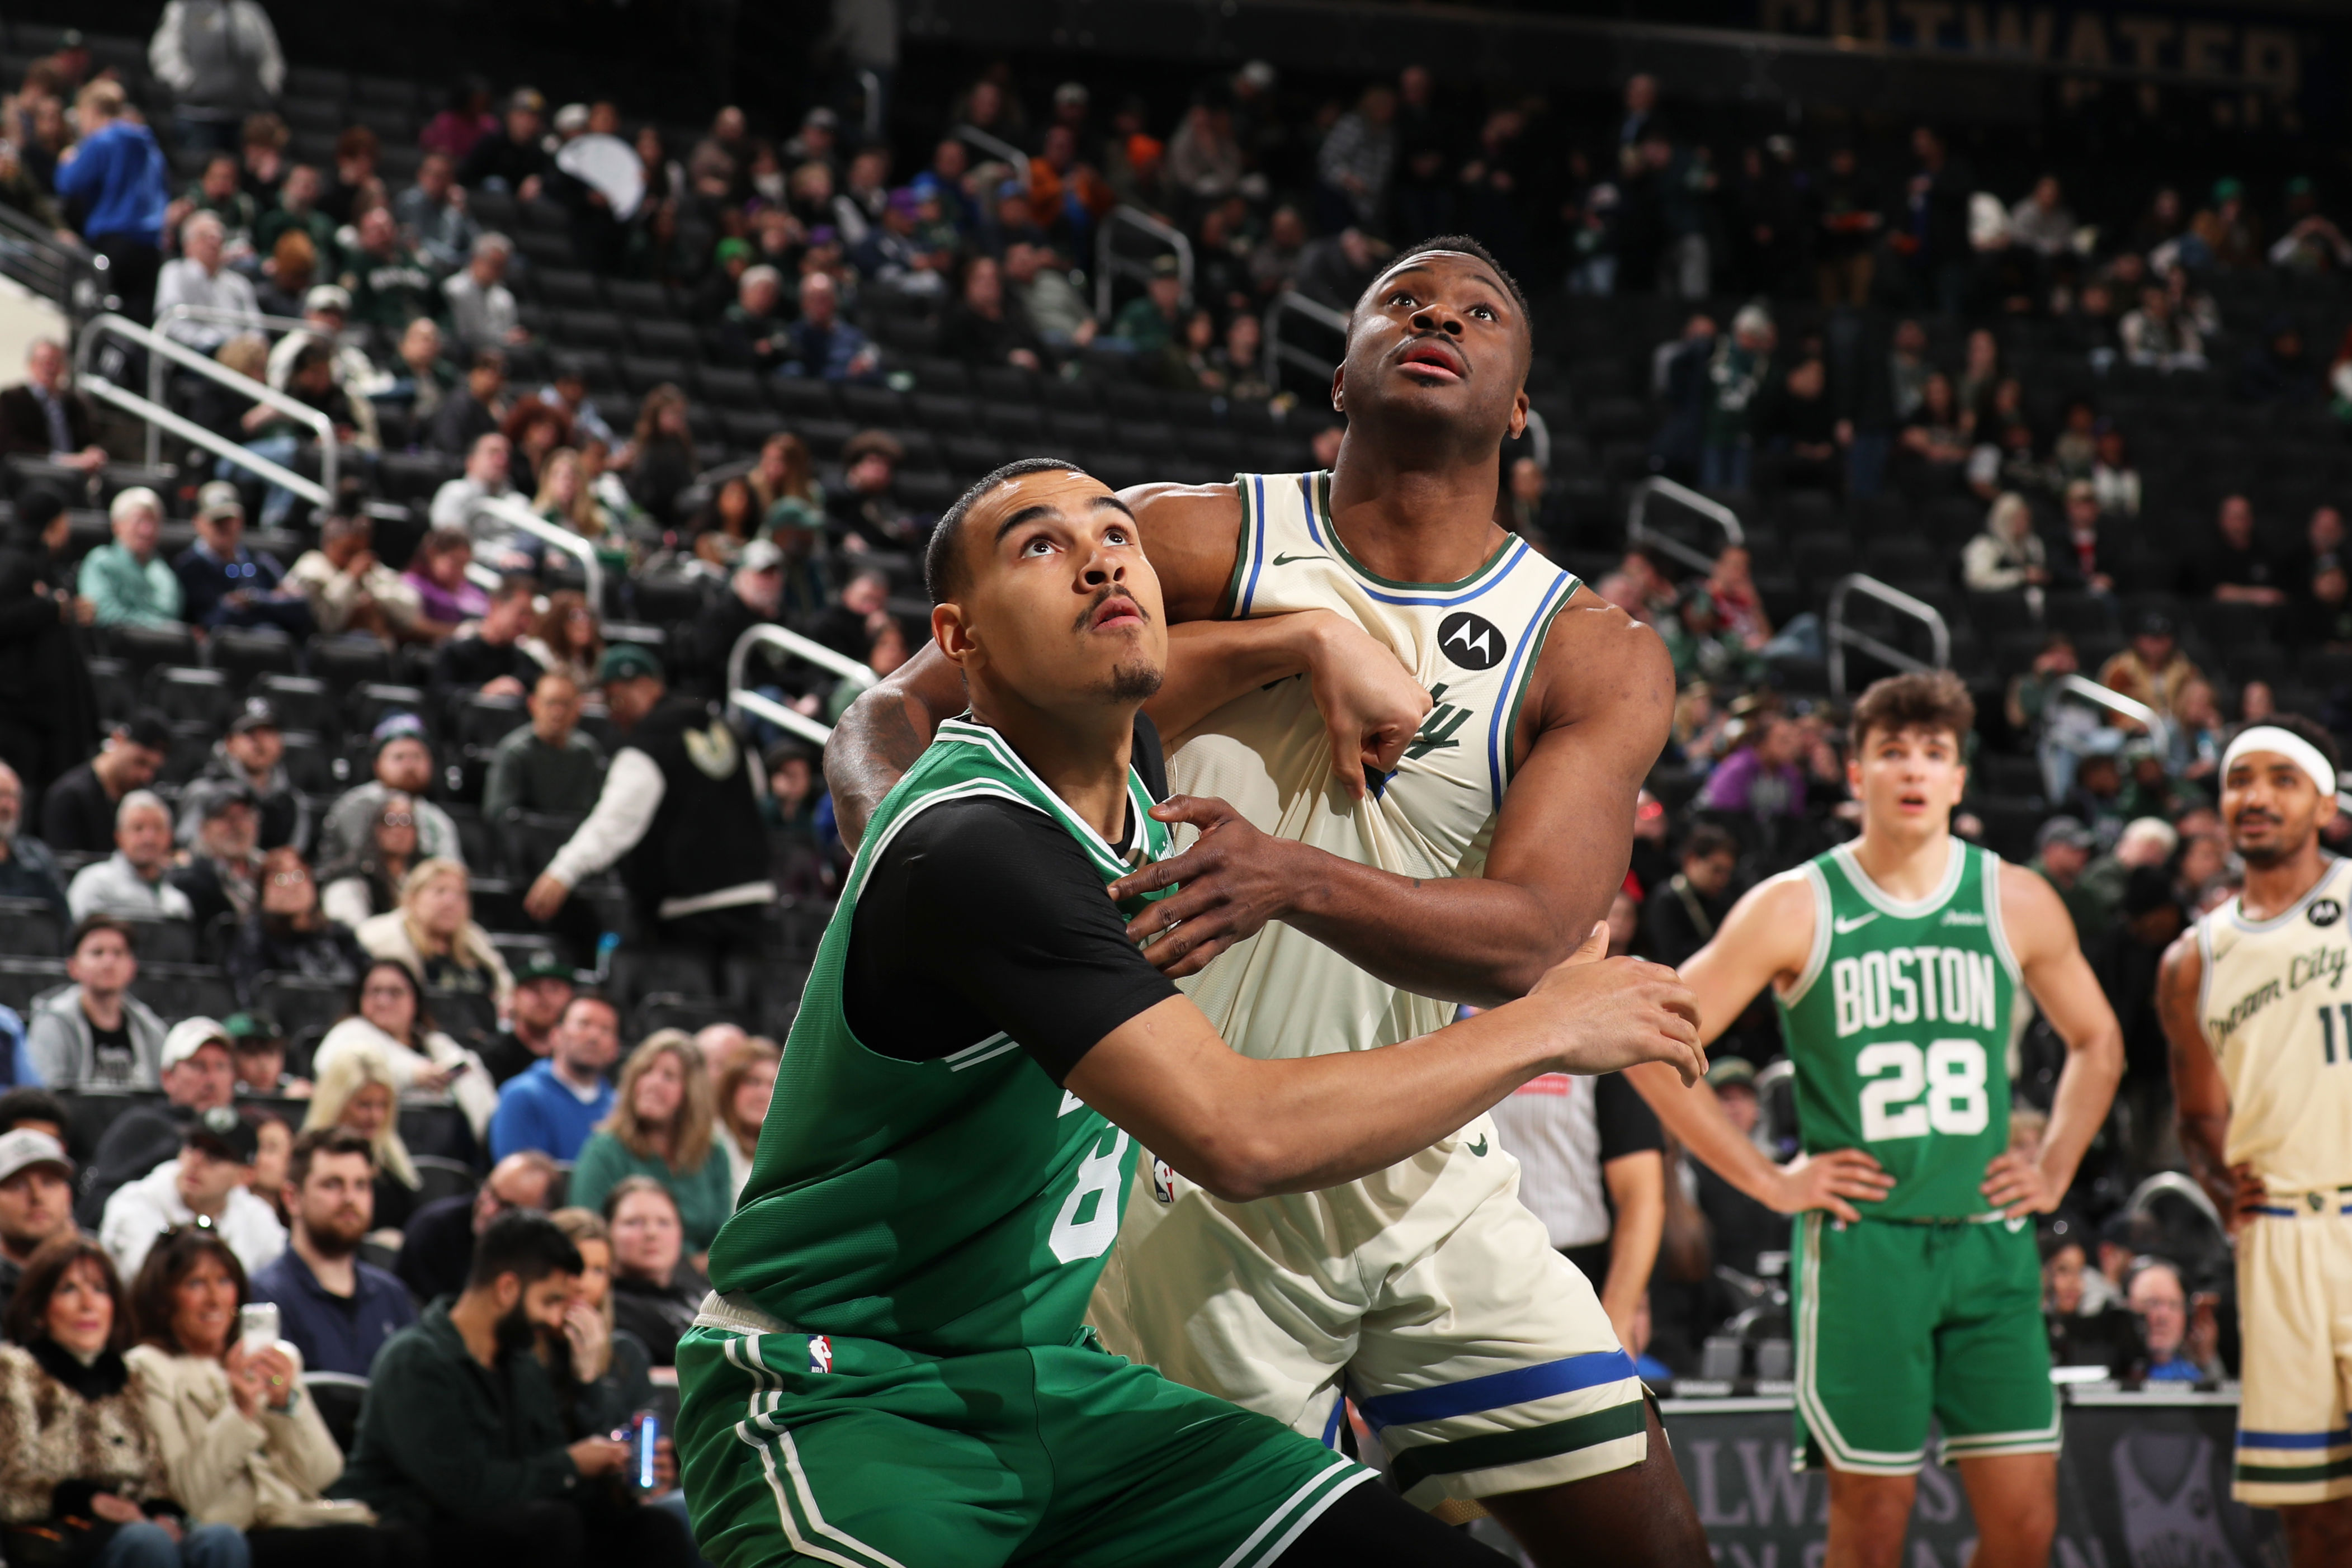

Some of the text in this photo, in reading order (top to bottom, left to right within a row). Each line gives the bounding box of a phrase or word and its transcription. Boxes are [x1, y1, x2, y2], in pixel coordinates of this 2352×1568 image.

[1831, 946, 1996, 1037] BOSTON
[2288, 945, 2348, 990] City
[1855, 1038, 1989, 1142] 28
